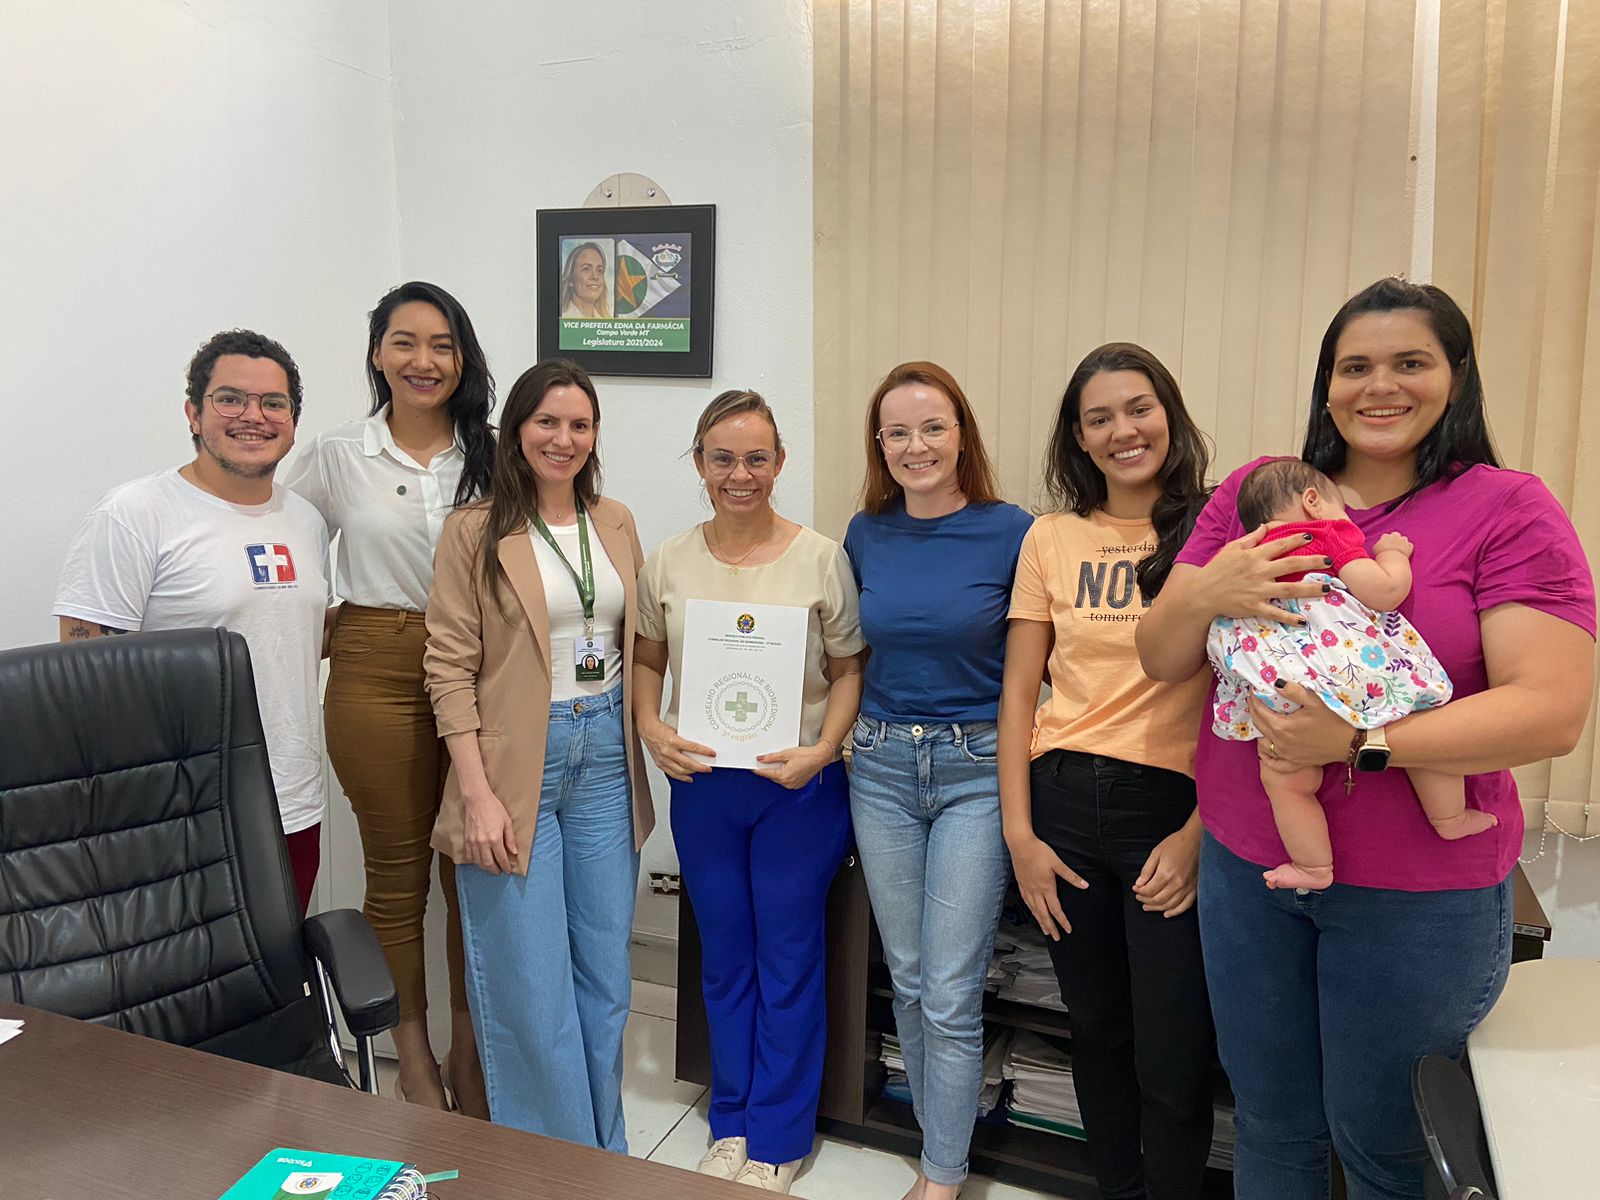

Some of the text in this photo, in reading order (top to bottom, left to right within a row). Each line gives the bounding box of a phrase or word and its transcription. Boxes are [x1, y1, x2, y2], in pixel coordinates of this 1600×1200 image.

[647, 321, 684, 330] FARMÁCIA
[596, 329, 619, 337] Campo
[582, 338, 663, 347] Legislatura 2021/2024
[1101, 541, 1158, 558] yesterda
[705, 672, 778, 732] CONSELHO REGIONAL DE BIOMEDICINA
